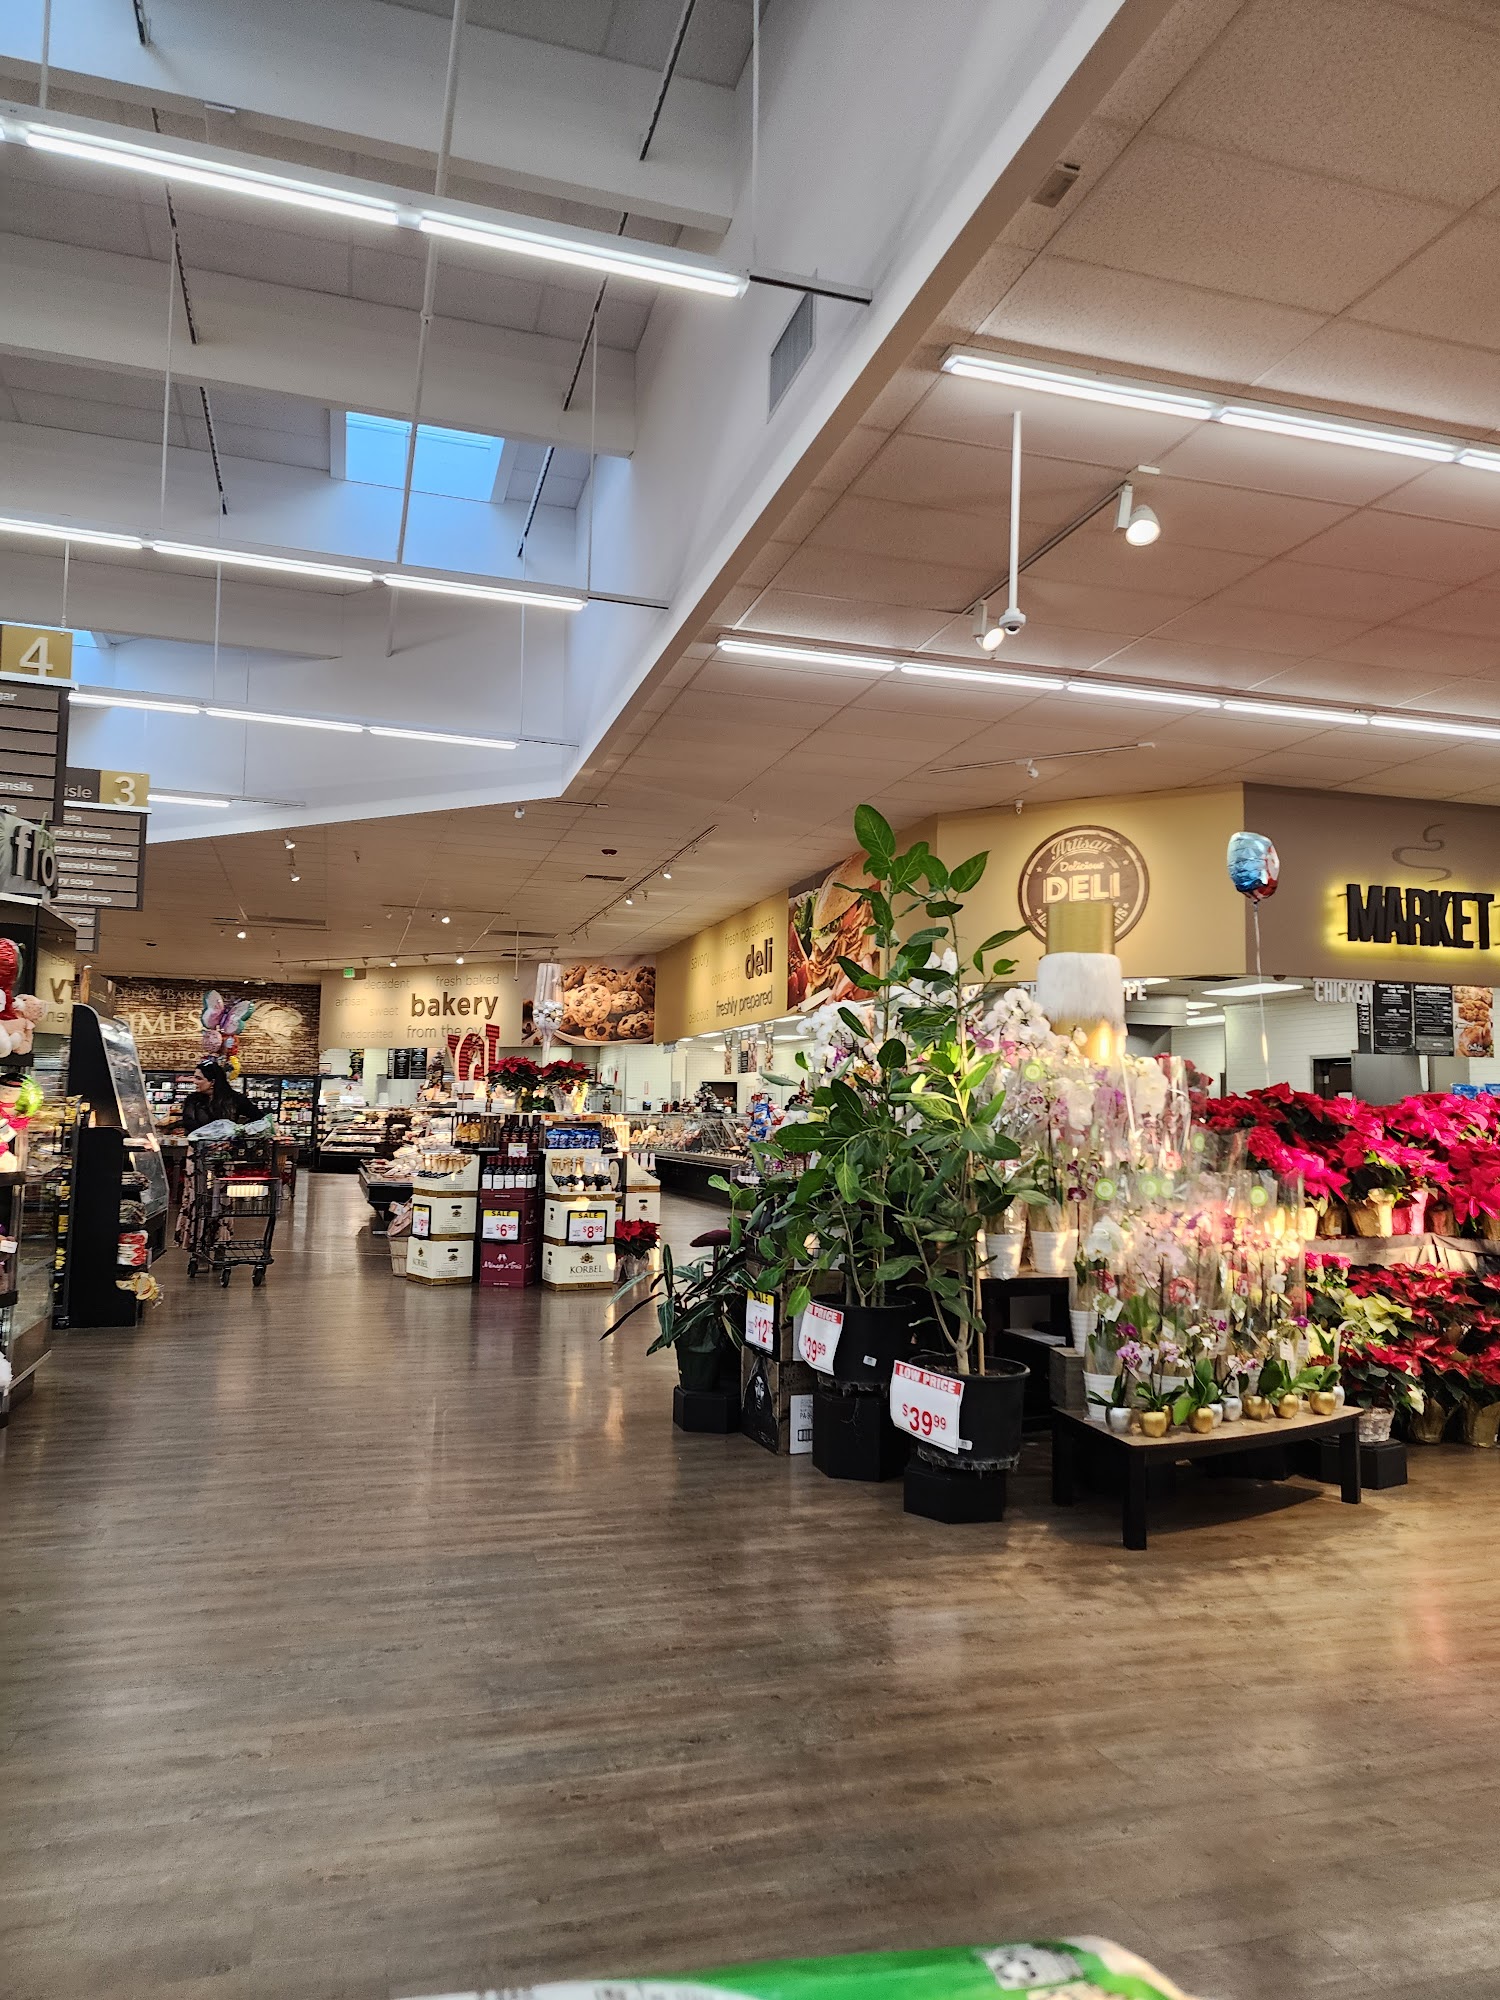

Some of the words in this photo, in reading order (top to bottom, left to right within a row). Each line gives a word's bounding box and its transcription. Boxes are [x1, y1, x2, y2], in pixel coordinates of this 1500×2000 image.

[19, 636, 54, 677] 4
[64, 784, 93, 799] isle
[114, 776, 136, 806] 3
[63, 814, 82, 822] asta
[98, 846, 133, 858] dinners
[1051, 837, 1113, 860] Artisan
[58, 861, 88, 870] anned
[1060, 860, 1105, 873] Delicious
[70, 878, 93, 887] soup
[1043, 872, 1121, 904] DELI
[58, 892, 88, 901] anned
[1346, 884, 1495, 950] MARKET
[745, 937, 774, 980] deli
[363, 978, 410, 990] decadent
[436, 975, 462, 988] fresh
[465, 974, 500, 986] baked
[1313, 980, 1374, 1003] CHICKEN
[411, 991, 499, 1020] bakery
[715, 994, 737, 1018] freshly
[738, 985, 773, 1016] prepared
[369, 1006, 400, 1017] sweet
[406, 1025, 437, 1039] from
[441, 1024, 462, 1037] the
[569, 1265, 603, 1274] KORBEL
[813, 1305, 838, 1323] PRICE
[898, 1365, 921, 1383] LOW
[922, 1372, 957, 1394] PRICE
